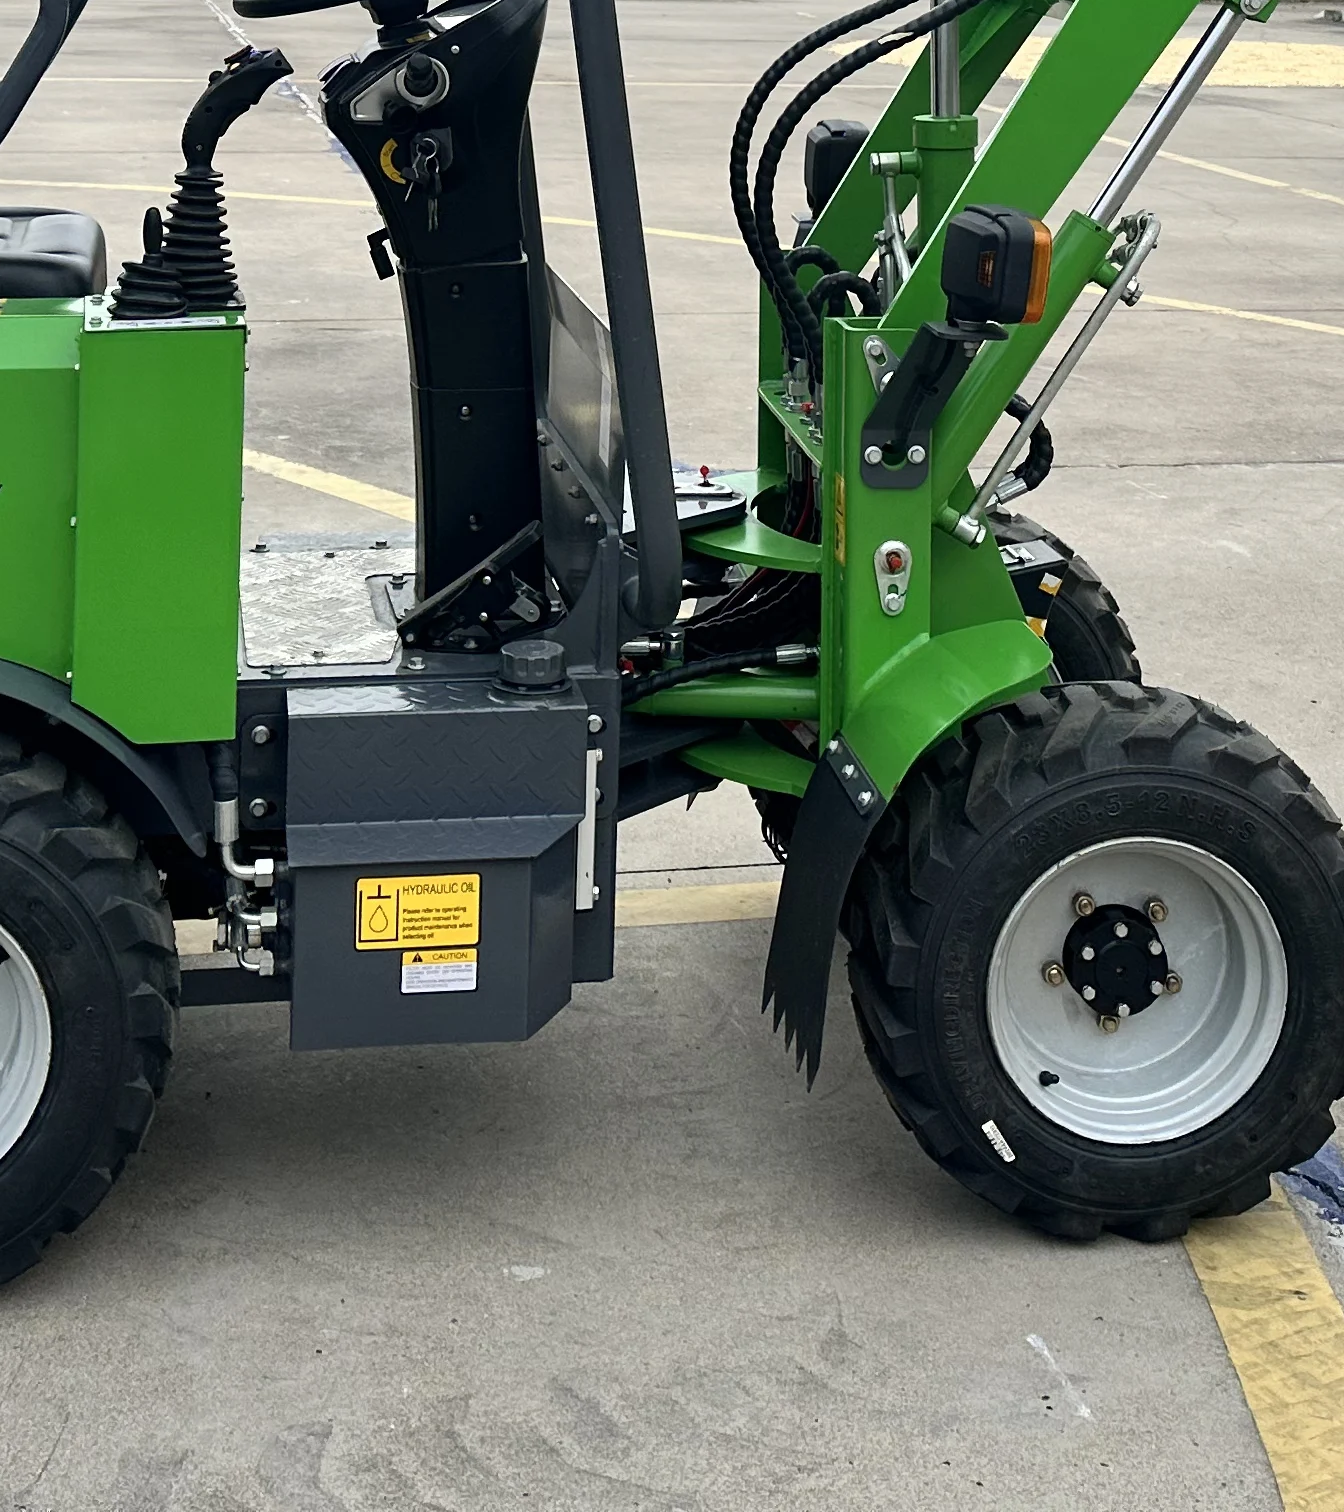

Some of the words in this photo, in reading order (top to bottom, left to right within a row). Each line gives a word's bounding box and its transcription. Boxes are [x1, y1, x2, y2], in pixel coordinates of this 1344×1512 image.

[1013, 789, 1173, 858] 23X8.5-12
[403, 883, 459, 895] HYDRAULIC
[432, 952, 468, 961] CAUTION
